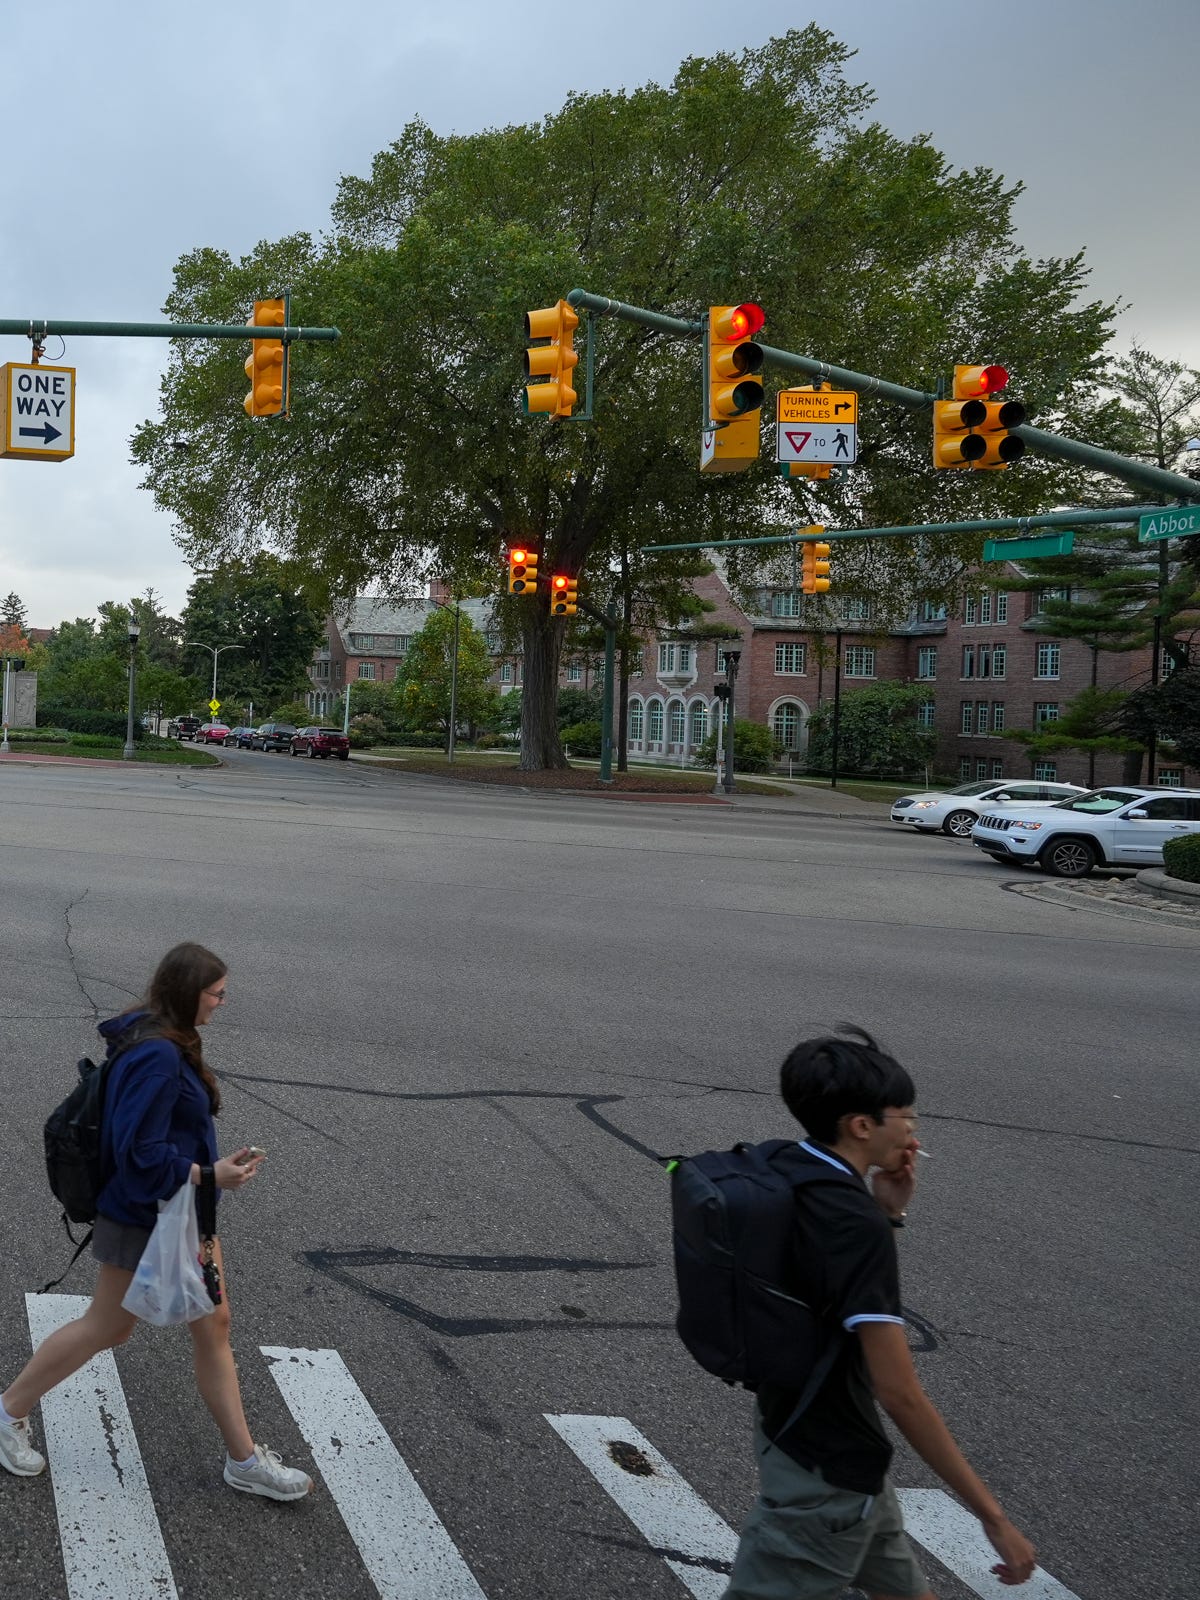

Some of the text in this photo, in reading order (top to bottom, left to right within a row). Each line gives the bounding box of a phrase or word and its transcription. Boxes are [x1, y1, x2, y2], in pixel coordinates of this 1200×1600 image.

[17, 374, 65, 395] ONE
[16, 396, 66, 418] WAY
[785, 396, 829, 406] TURNING
[784, 409, 831, 419] VEHICLES
[813, 438, 826, 447] TO
[1145, 515, 1195, 537] Abbot
